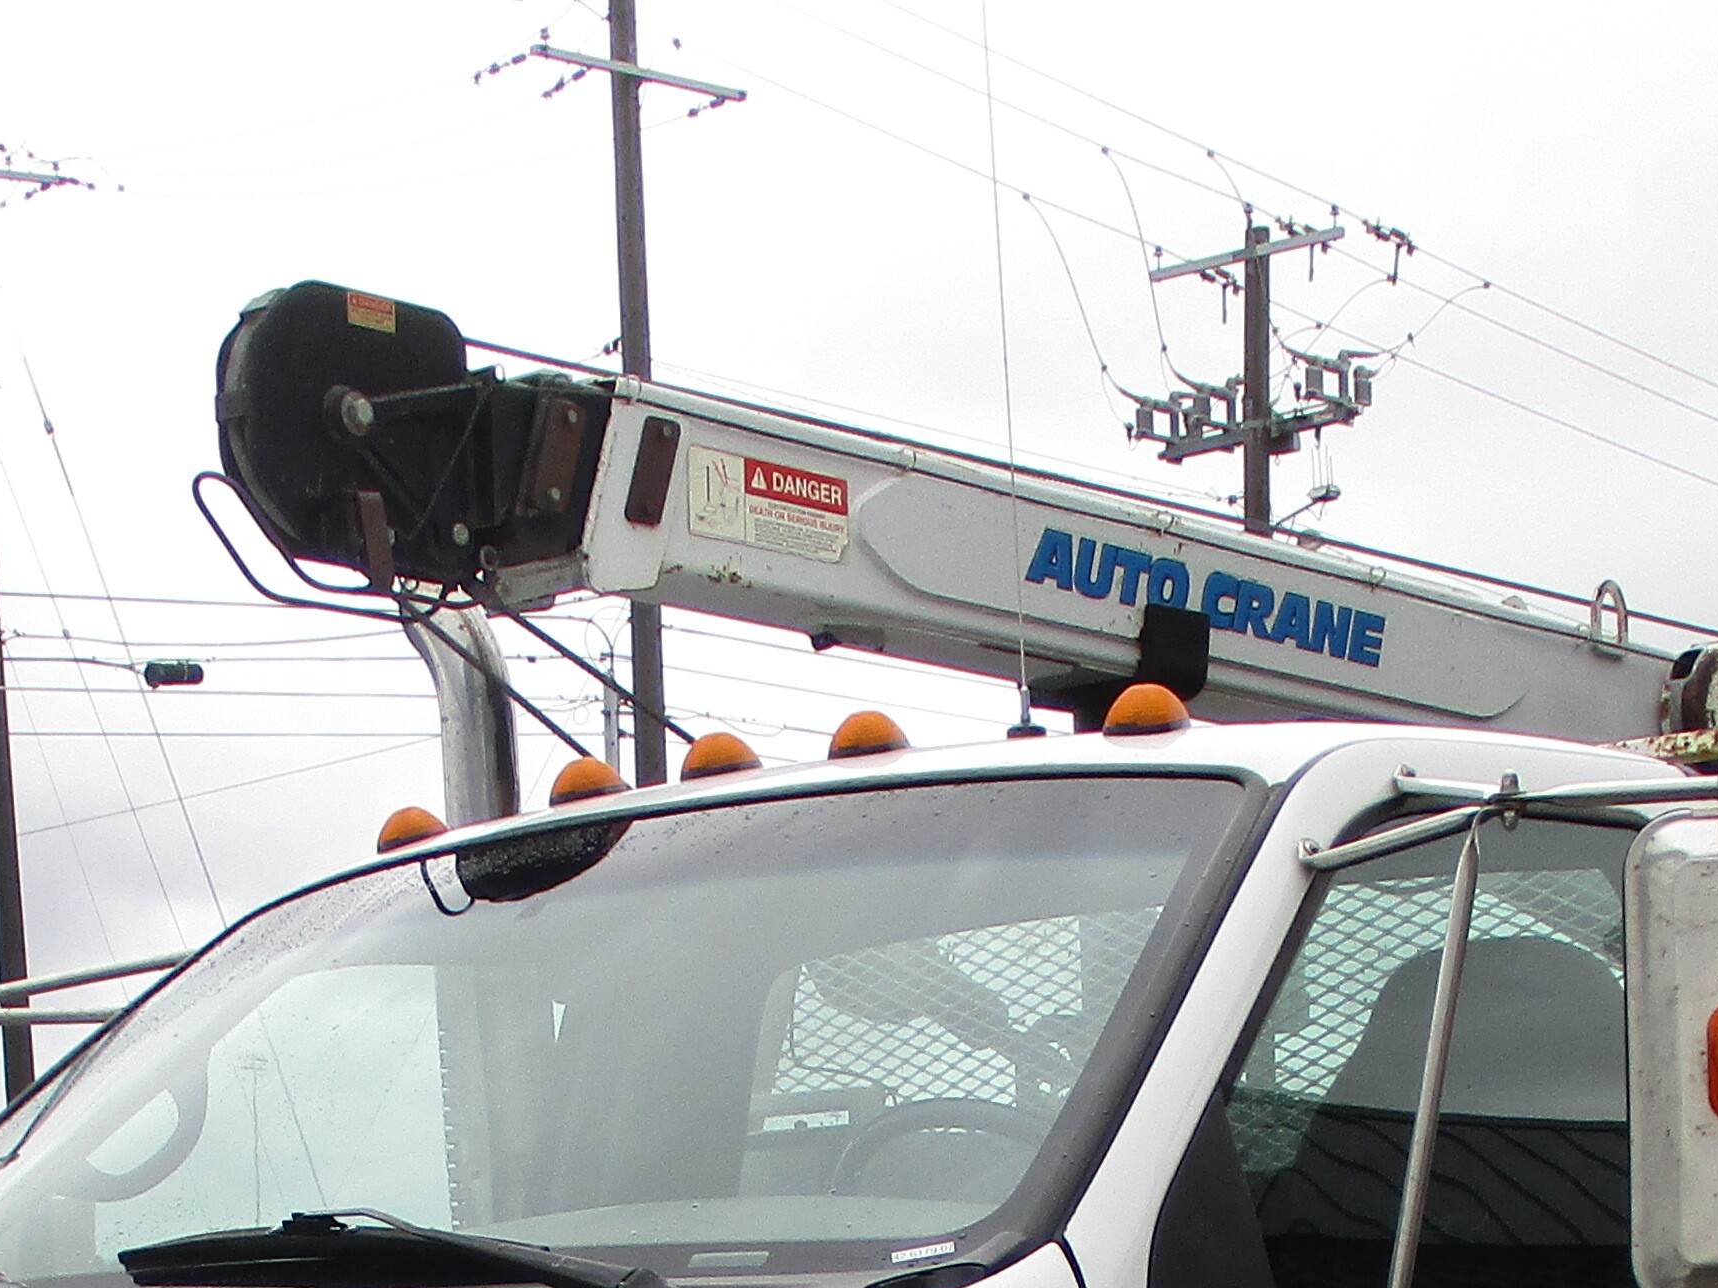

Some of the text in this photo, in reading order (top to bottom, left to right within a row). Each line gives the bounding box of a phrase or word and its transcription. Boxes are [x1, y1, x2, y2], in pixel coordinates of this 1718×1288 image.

[772, 471, 843, 507] DANGER
[1025, 527, 1387, 668] AUTO CRANE
